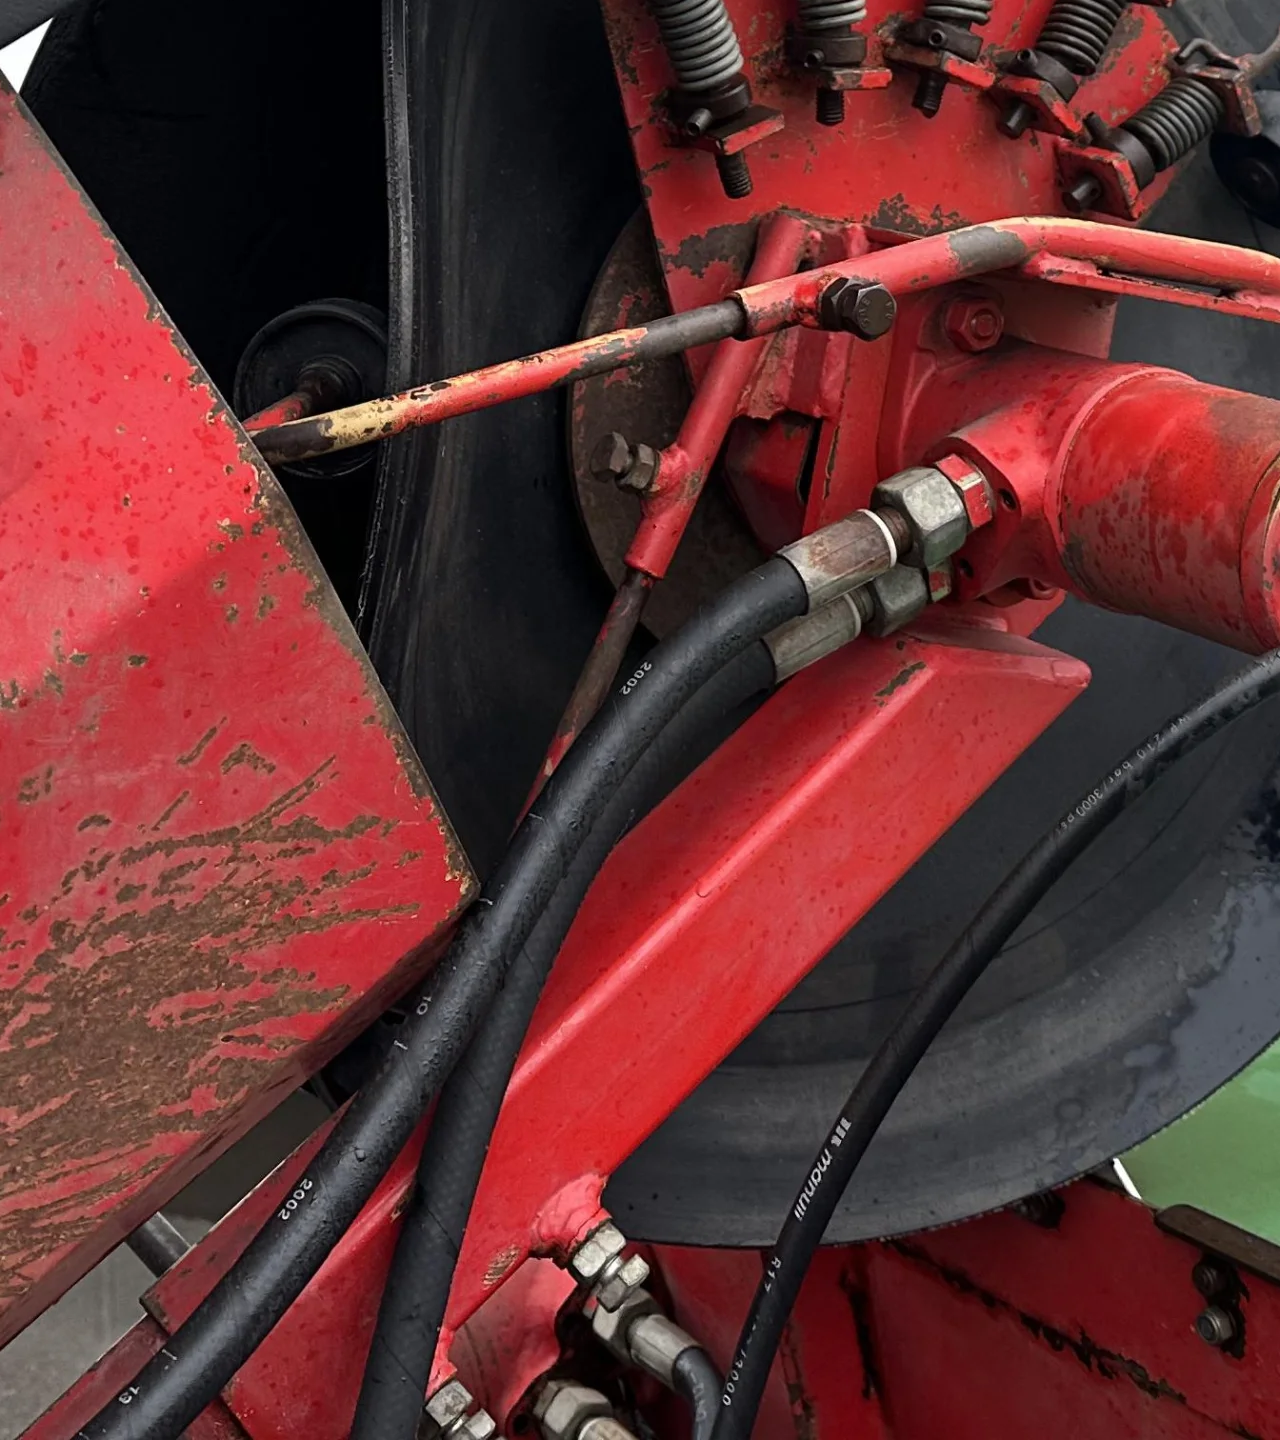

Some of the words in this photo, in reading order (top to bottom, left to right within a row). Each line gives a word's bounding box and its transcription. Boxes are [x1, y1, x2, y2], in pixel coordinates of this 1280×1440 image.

[619, 661, 652, 695] 2002
[278, 1178, 313, 1221] 2002
[793, 1148, 833, 1222] manuli
